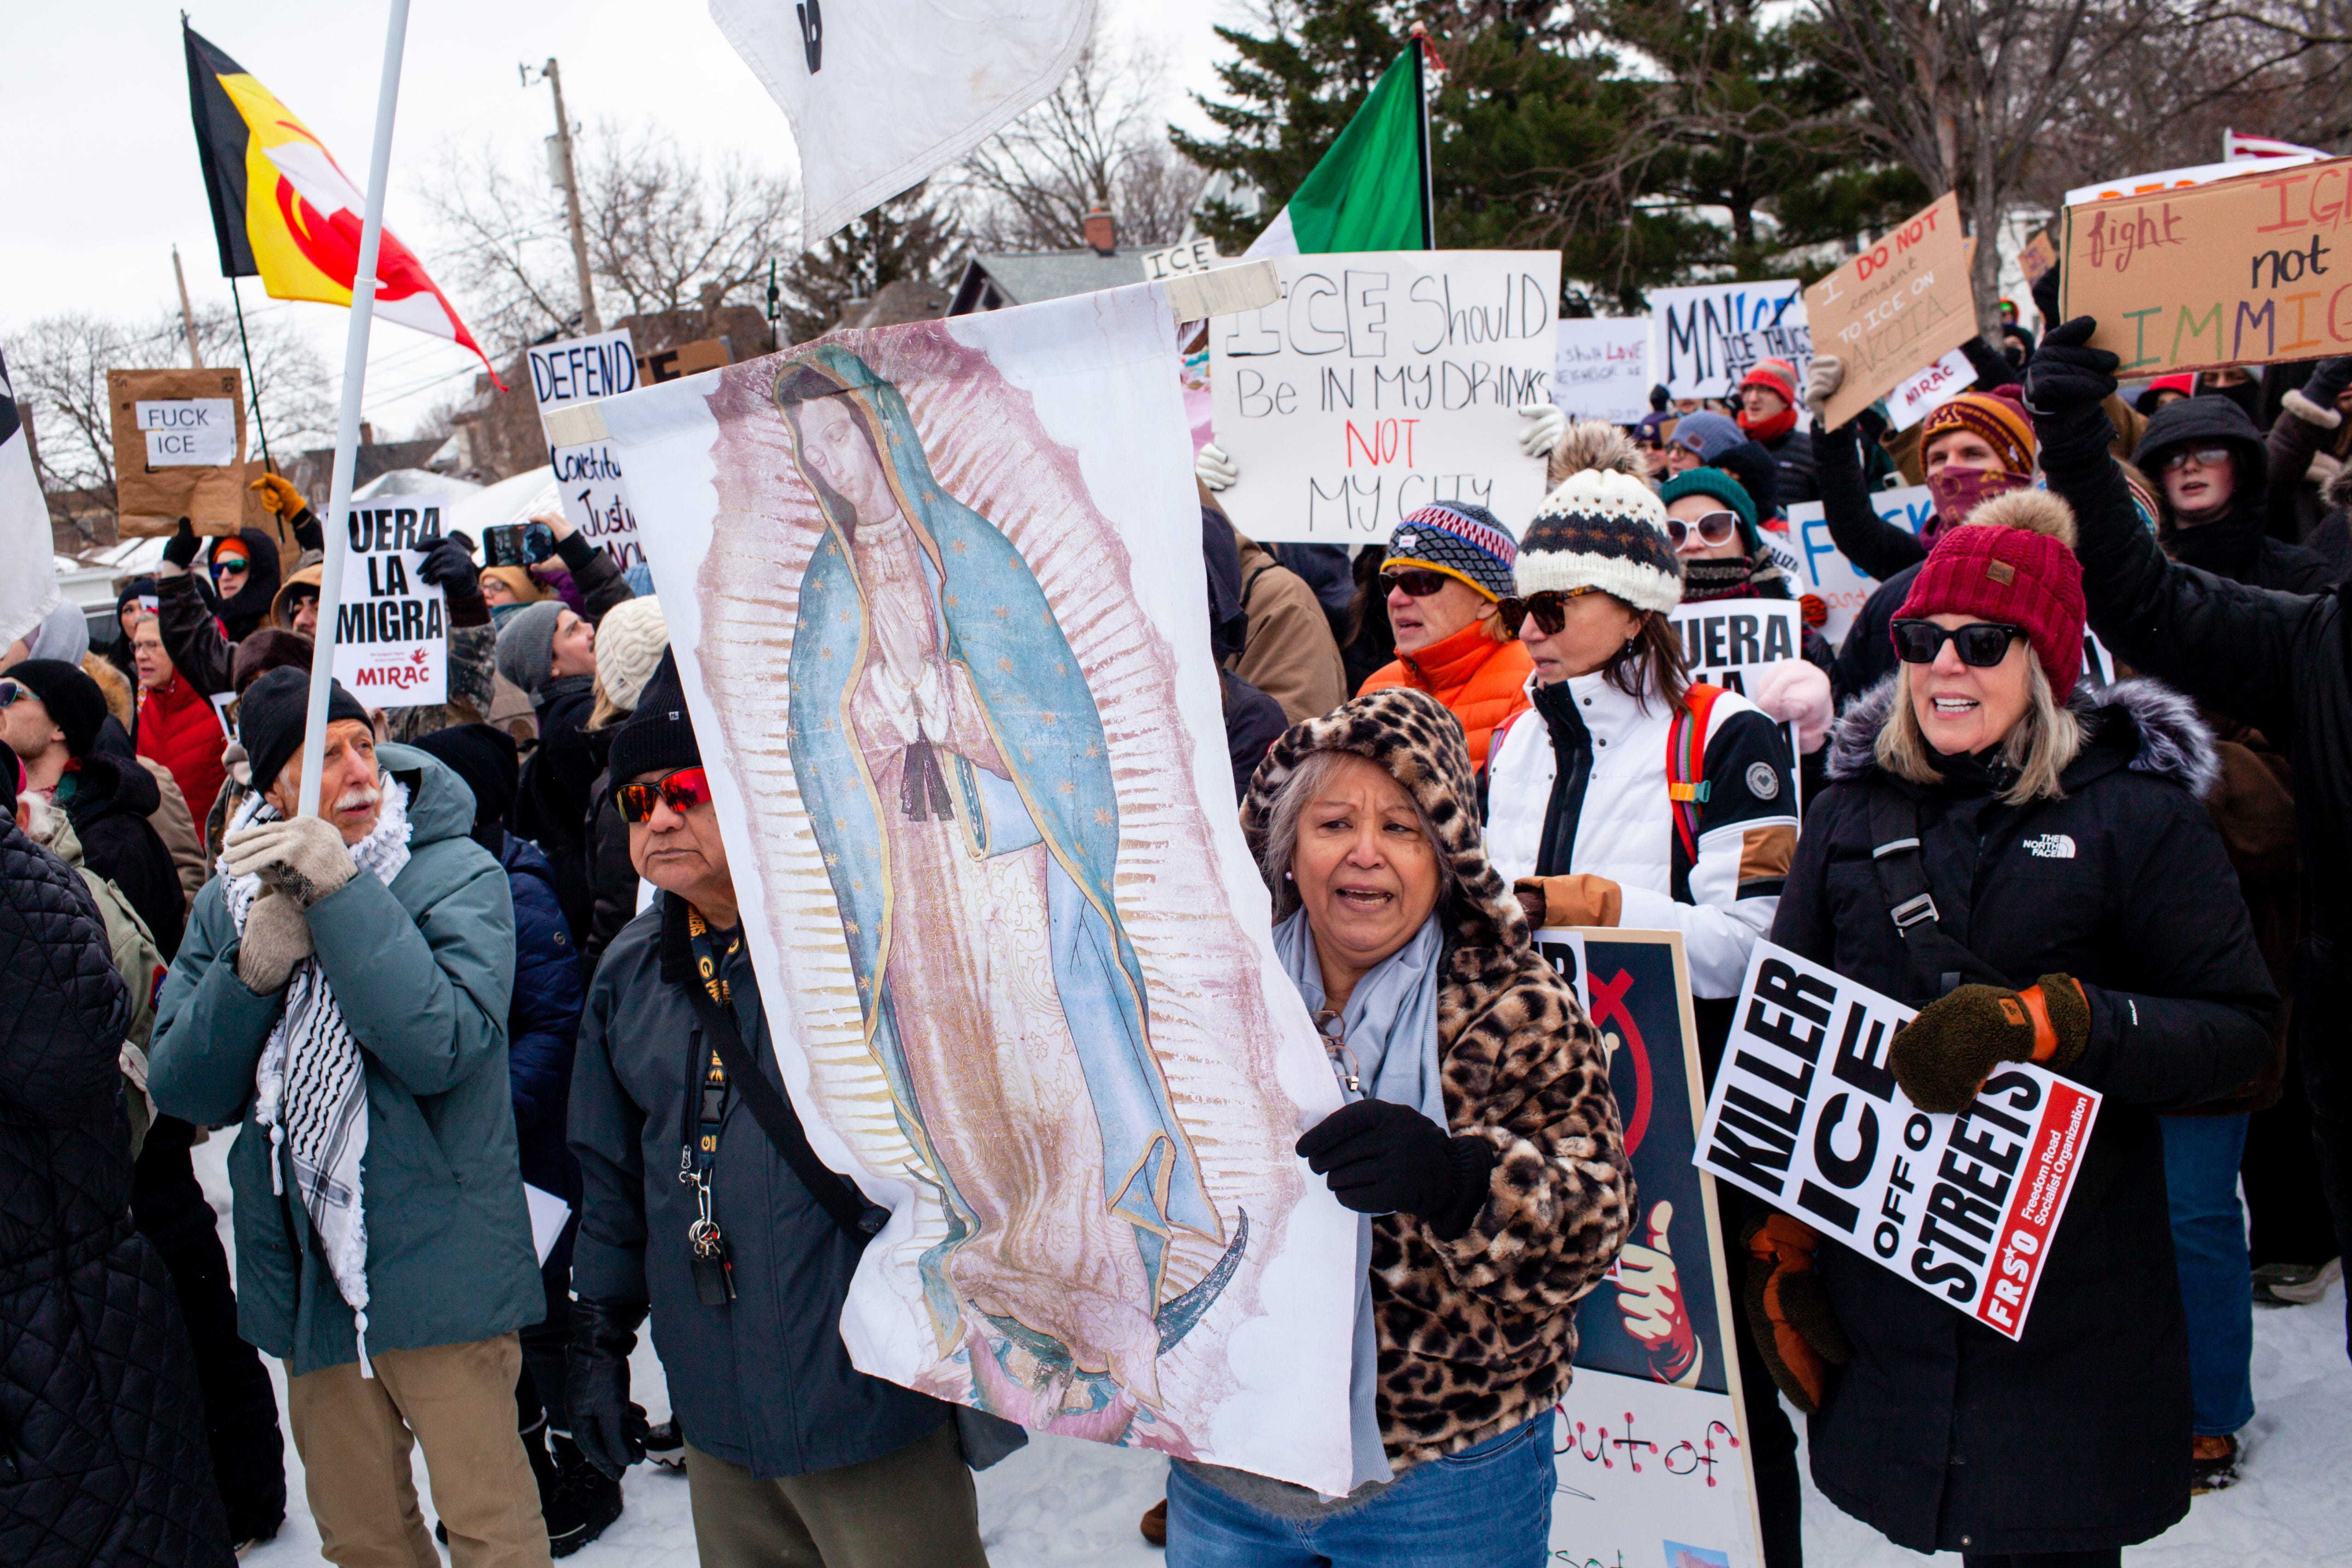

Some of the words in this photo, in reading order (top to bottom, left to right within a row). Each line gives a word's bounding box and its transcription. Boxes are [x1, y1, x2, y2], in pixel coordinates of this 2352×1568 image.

[1148, 241, 1209, 279] ICE
[1819, 275, 1843, 306] I
[1856, 247, 1888, 282] DO
[1896, 209, 1939, 254] NOT
[2086, 203, 2183, 273] fight
[2252, 234, 2331, 289] not
[1837, 321, 1862, 345] TO
[1864, 290, 1906, 331] ICE
[1911, 271, 1935, 295] ON
[1722, 333, 1755, 362] ICE
[1843, 294, 1949, 385] AKOTA
[530, 341, 635, 402] DEFEND
[1237, 369, 1298, 418] Be
[1321, 366, 1354, 411] IN
[1442, 361, 1552, 411] DRINKS
[148, 408, 209, 427] FUCK
[159, 435, 195, 453] ICE
[1346, 418, 1420, 468] NOT
[326, 507, 440, 552] UERA
[368, 556, 409, 597] LA
[335, 599, 443, 644] MIGRA
[1670, 614, 1793, 669] UERA
[356, 666, 429, 689] MIRAC
[2023, 840, 2058, 850] NORTH
[2032, 848, 2057, 857] FACE
[2040, 834, 2060, 842] THE
[1706, 957, 1838, 1197] KILLER
[1797, 1001, 1910, 1234] ICE
[1911, 1070, 2041, 1303] STREETS
[2021, 1164, 2050, 1221] Freedom
[2041, 1129, 2062, 1163] Road
[2034, 1173, 2062, 1227] Socialist
[2053, 1097, 2088, 1173] Organization
[1874, 1154, 1915, 1259] OFF
[1665, 1421, 1740, 1488] of
